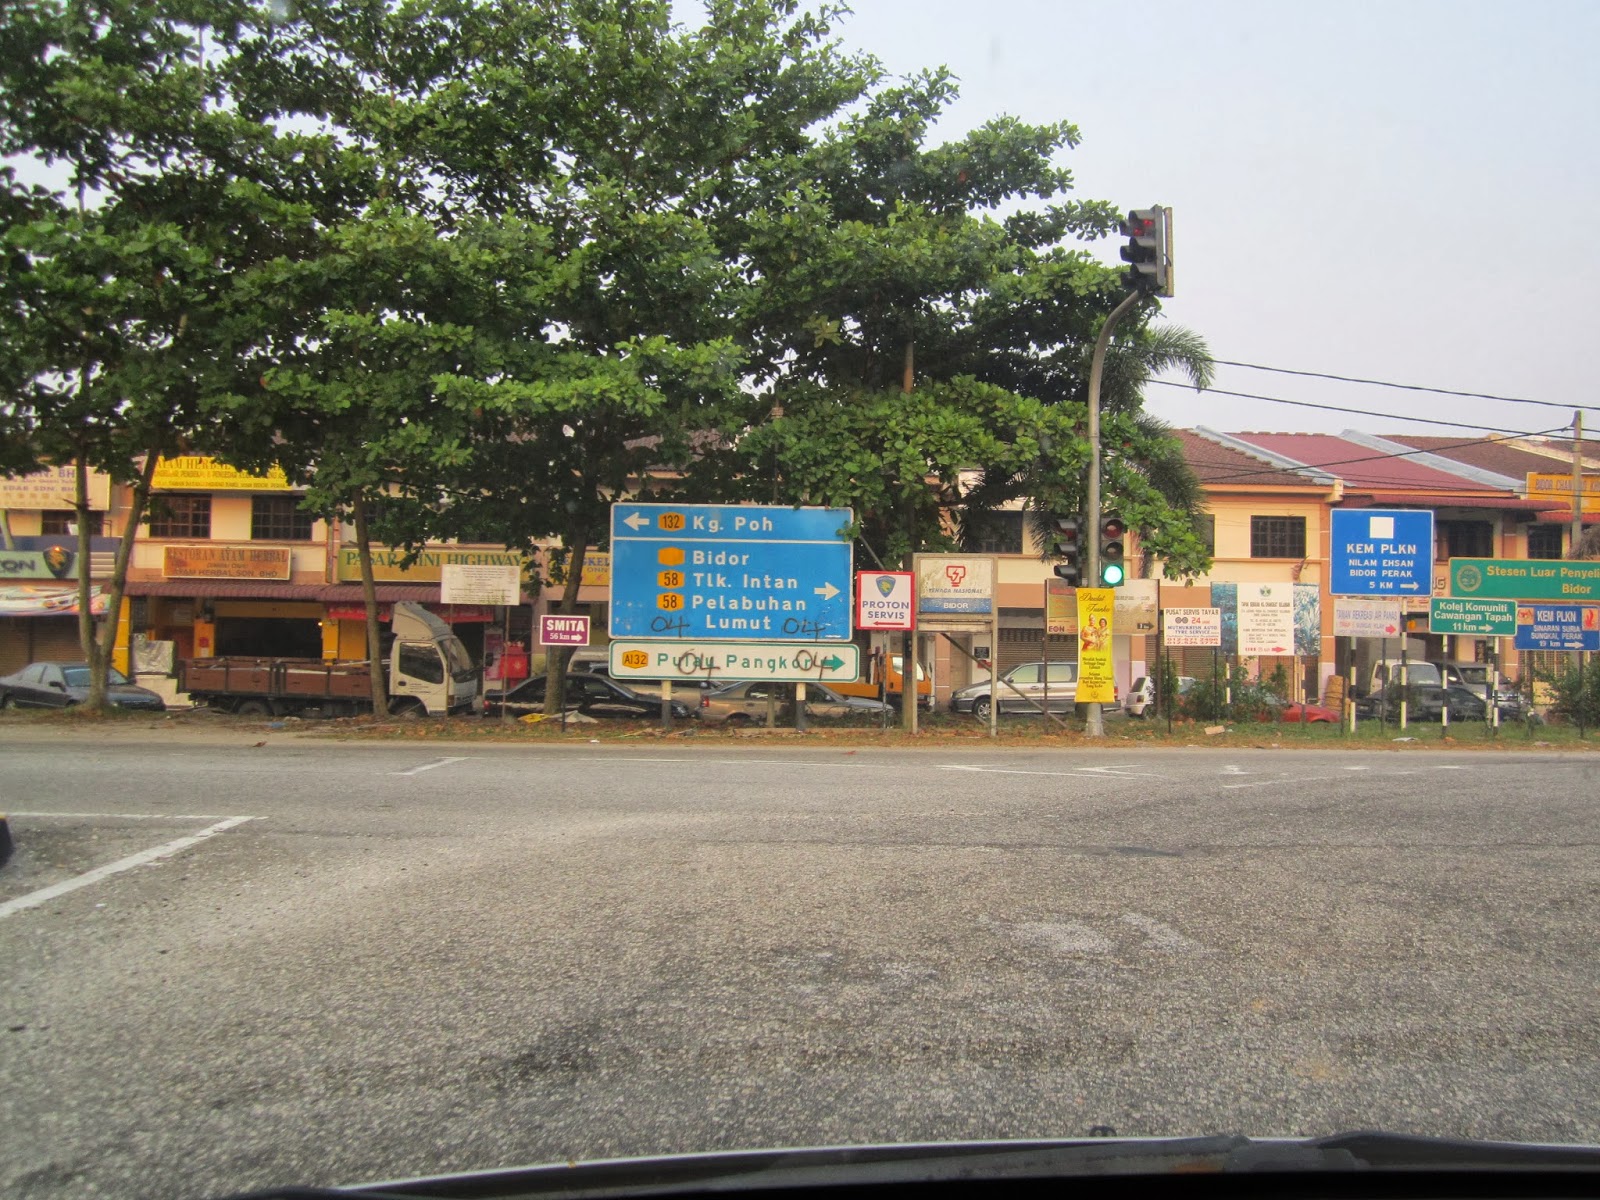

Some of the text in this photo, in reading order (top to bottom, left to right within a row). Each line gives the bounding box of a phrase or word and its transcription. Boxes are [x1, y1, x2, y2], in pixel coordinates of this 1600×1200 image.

[662, 514, 680, 528] 132
[693, 516, 773, 532] Kg. Poh
[220, 549, 245, 561] AYAM
[1346, 544, 1416, 554] KEM PLKN
[447, 553, 522, 566] HIGHWAY
[693, 551, 750, 566] Bidor
[1487, 566, 1526, 576] Stesen
[1531, 566, 1556, 577] Luar
[664, 574, 678, 587] 58
[693, 573, 798, 589] Tlk. Intan
[1562, 584, 1592, 594] Bidor
[663, 594, 677, 608] 58
[692, 596, 806, 611] Pelabuhan
[1440, 602, 1463, 612] Kolej
[1466, 603, 1508, 612] Komuniti
[868, 611, 904, 619] SERVIS
[1434, 611, 1512, 623] Cawangan Tapah
[1537, 610, 1576, 622] KEM PLKN
[547, 620, 585, 632] SMITA
[706, 615, 771, 630] Lumut
[1452, 622, 1476, 631] 11 km
[624, 654, 646, 665] A132
[726, 654, 811, 672] Pangkor
